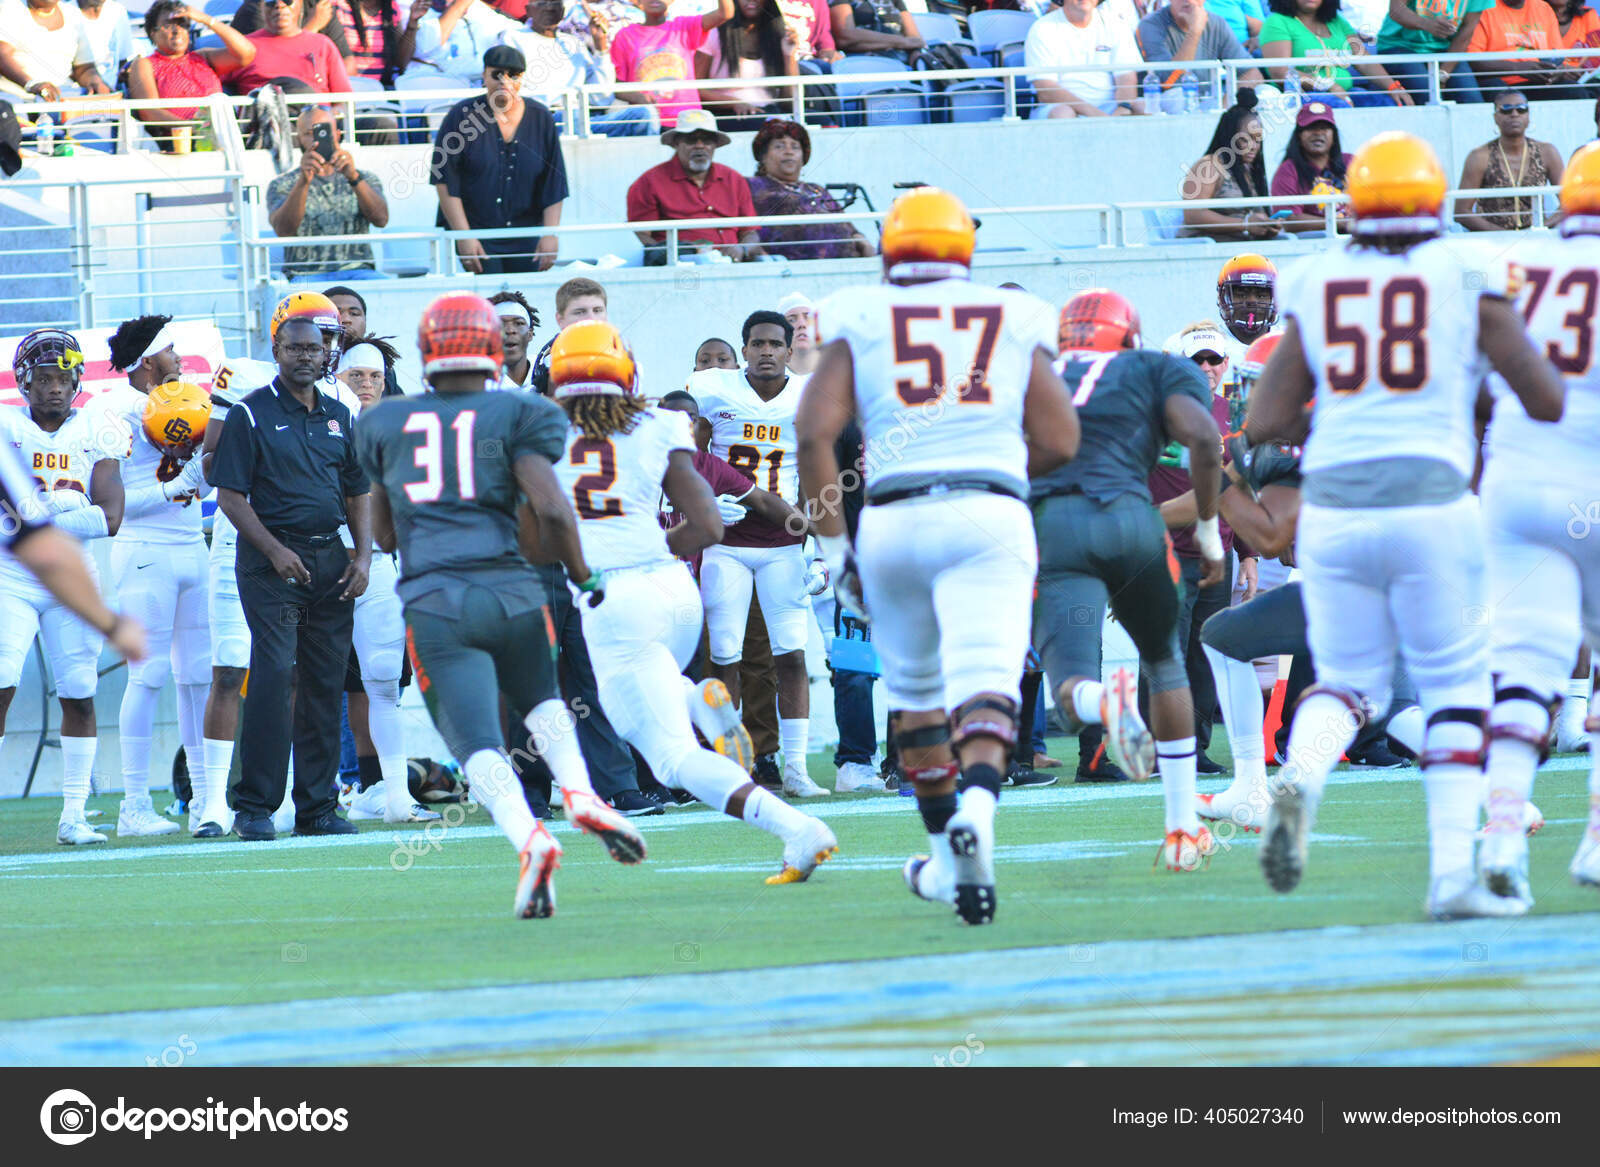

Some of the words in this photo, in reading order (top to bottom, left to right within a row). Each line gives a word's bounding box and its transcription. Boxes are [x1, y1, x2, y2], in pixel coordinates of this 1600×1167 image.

[891, 305, 1004, 407] 57
[1325, 276, 1428, 394] 58
[1524, 267, 1599, 376] 73
[32, 452, 70, 471] BCU
[403, 409, 477, 504] 31
[570, 435, 627, 520] 2
[743, 422, 782, 443] BCU
